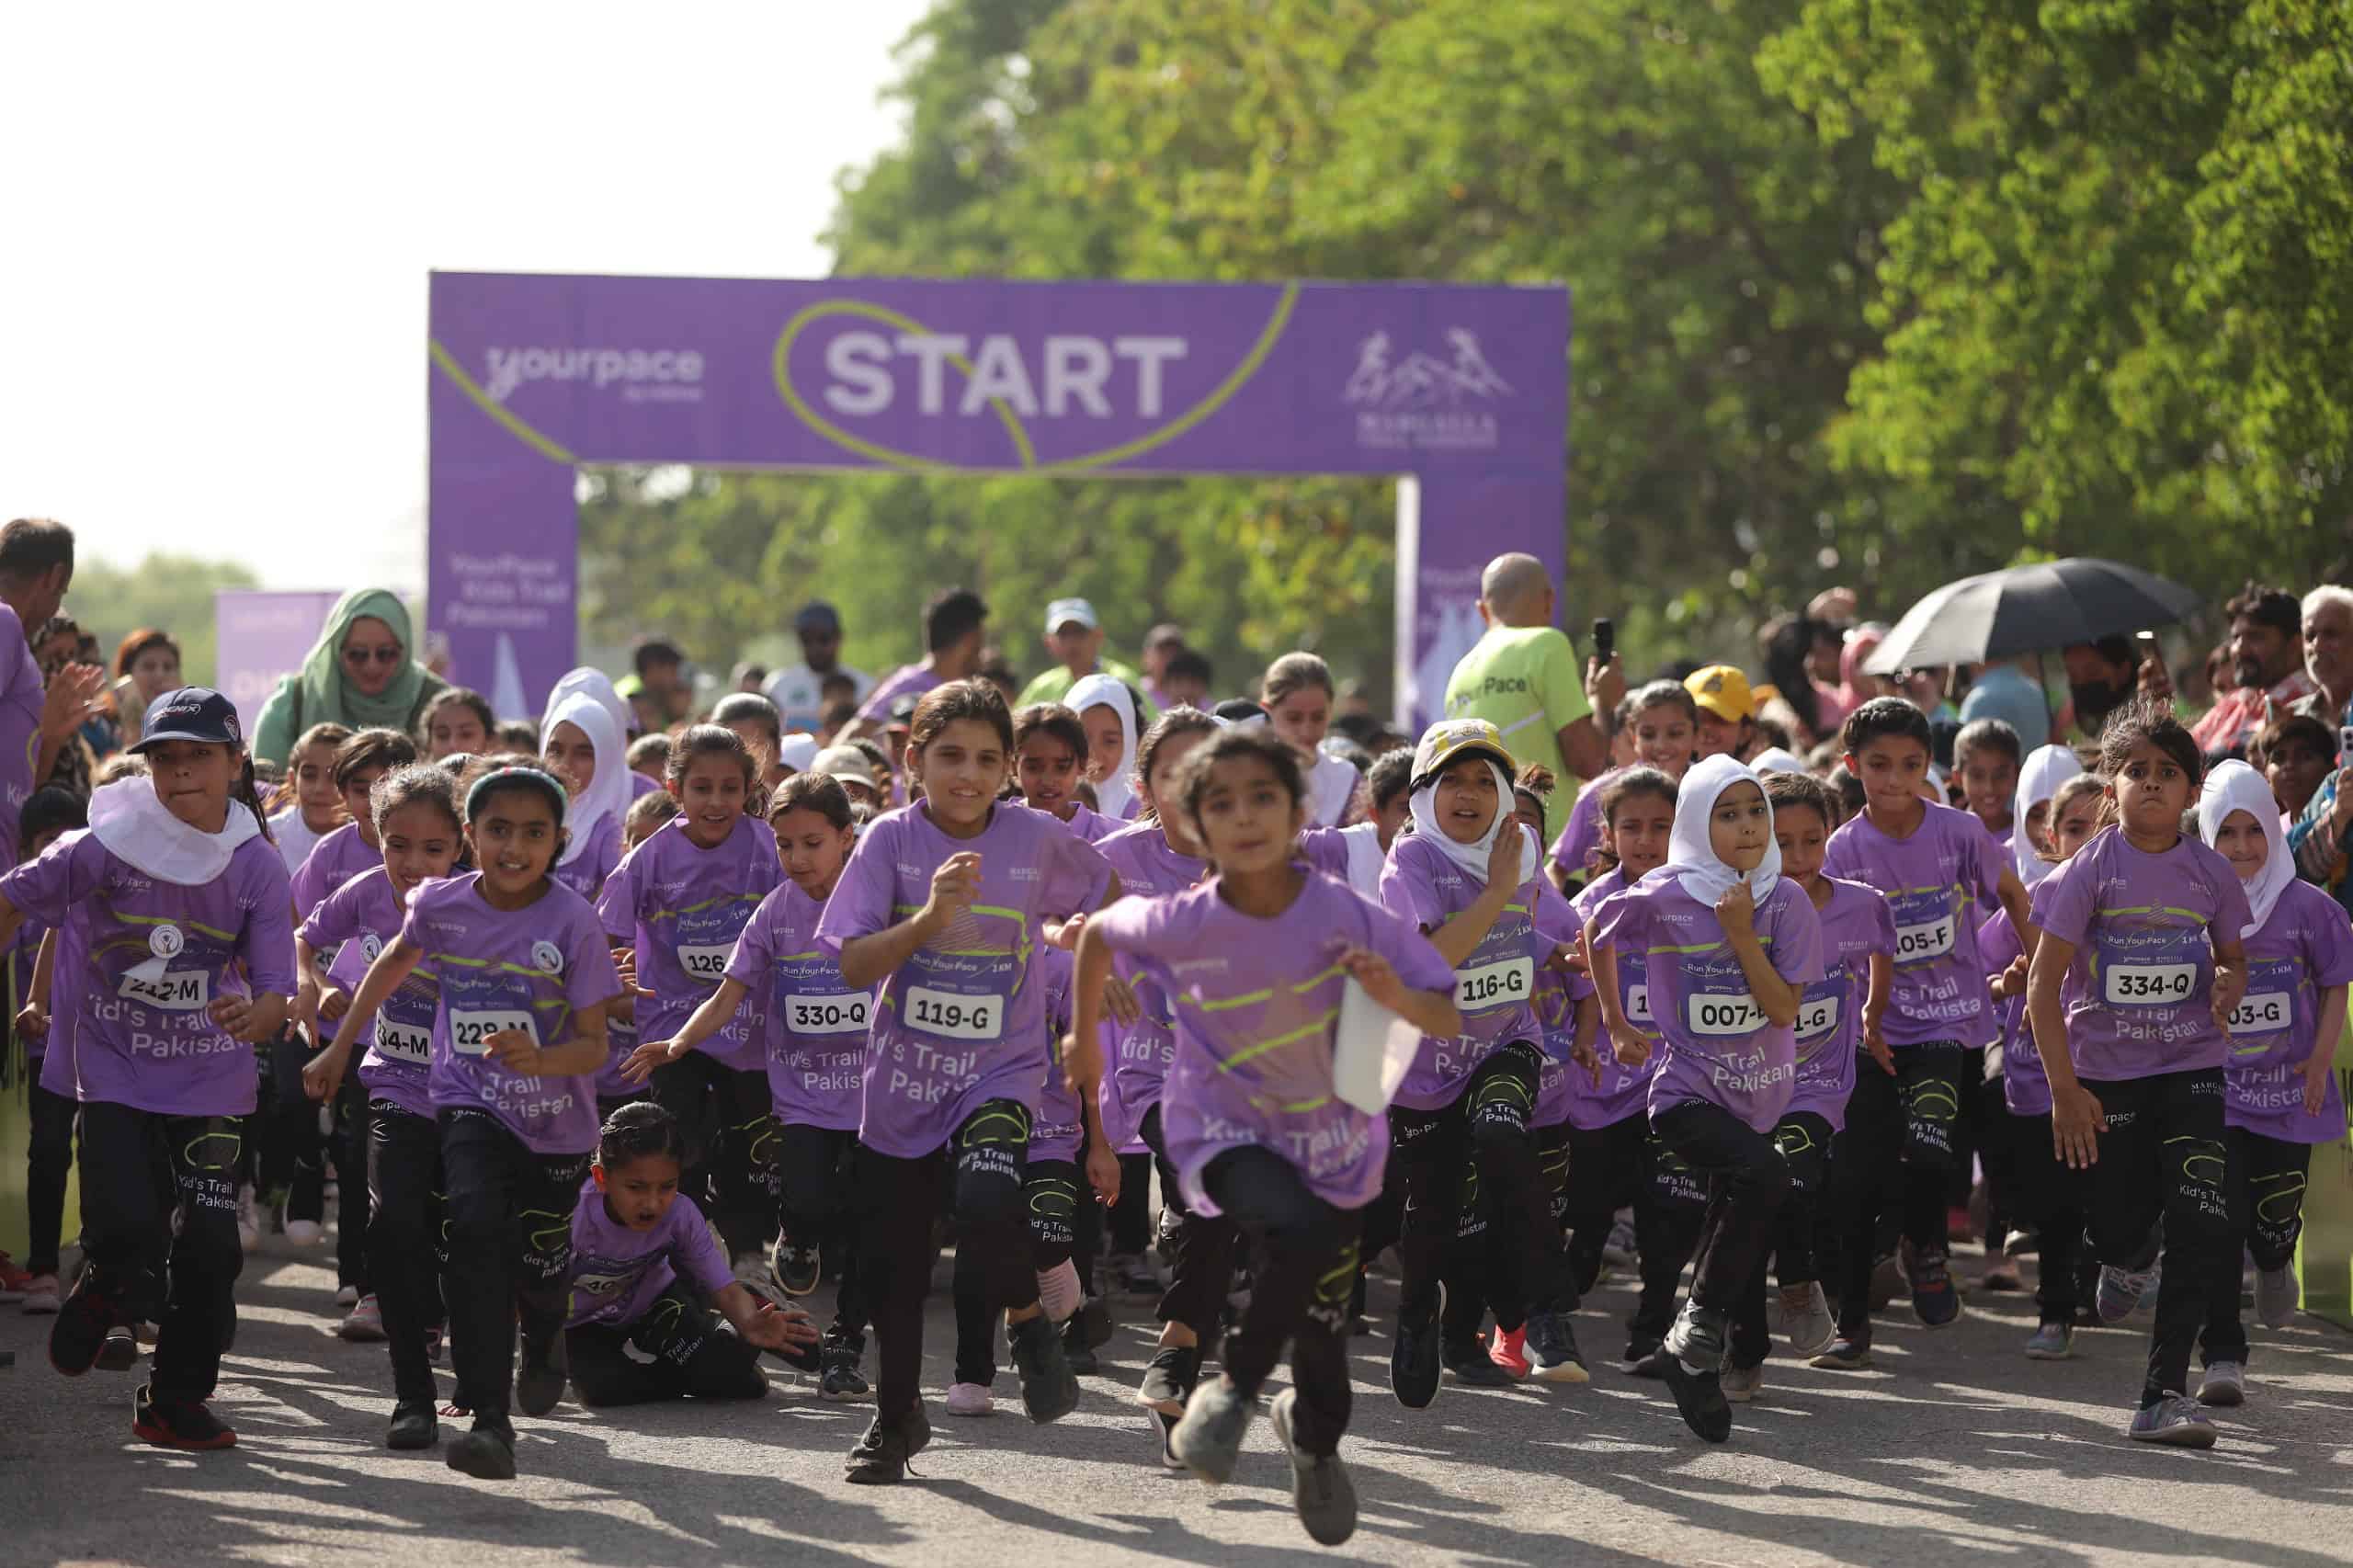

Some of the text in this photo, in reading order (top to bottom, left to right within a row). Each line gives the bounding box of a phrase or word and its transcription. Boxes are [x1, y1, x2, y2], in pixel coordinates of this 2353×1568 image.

[484, 347, 704, 402] yourpace
[824, 330, 1188, 417] START
[1483, 676, 1526, 694] Pace
[1688, 963, 1704, 972] Run
[1462, 970, 1523, 1002] 116-G
[2118, 973, 2189, 995] 334-Q
[795, 1002, 866, 1026] 330-Q
[915, 999, 989, 1030] 119-G
[131, 1032, 244, 1058] Pakista
[816, 1050, 864, 1068] Trail
[983, 1148, 1014, 1164] Trail
[207, 1179, 233, 1194] Trail
[2179, 1184, 2207, 1200] Kid's
